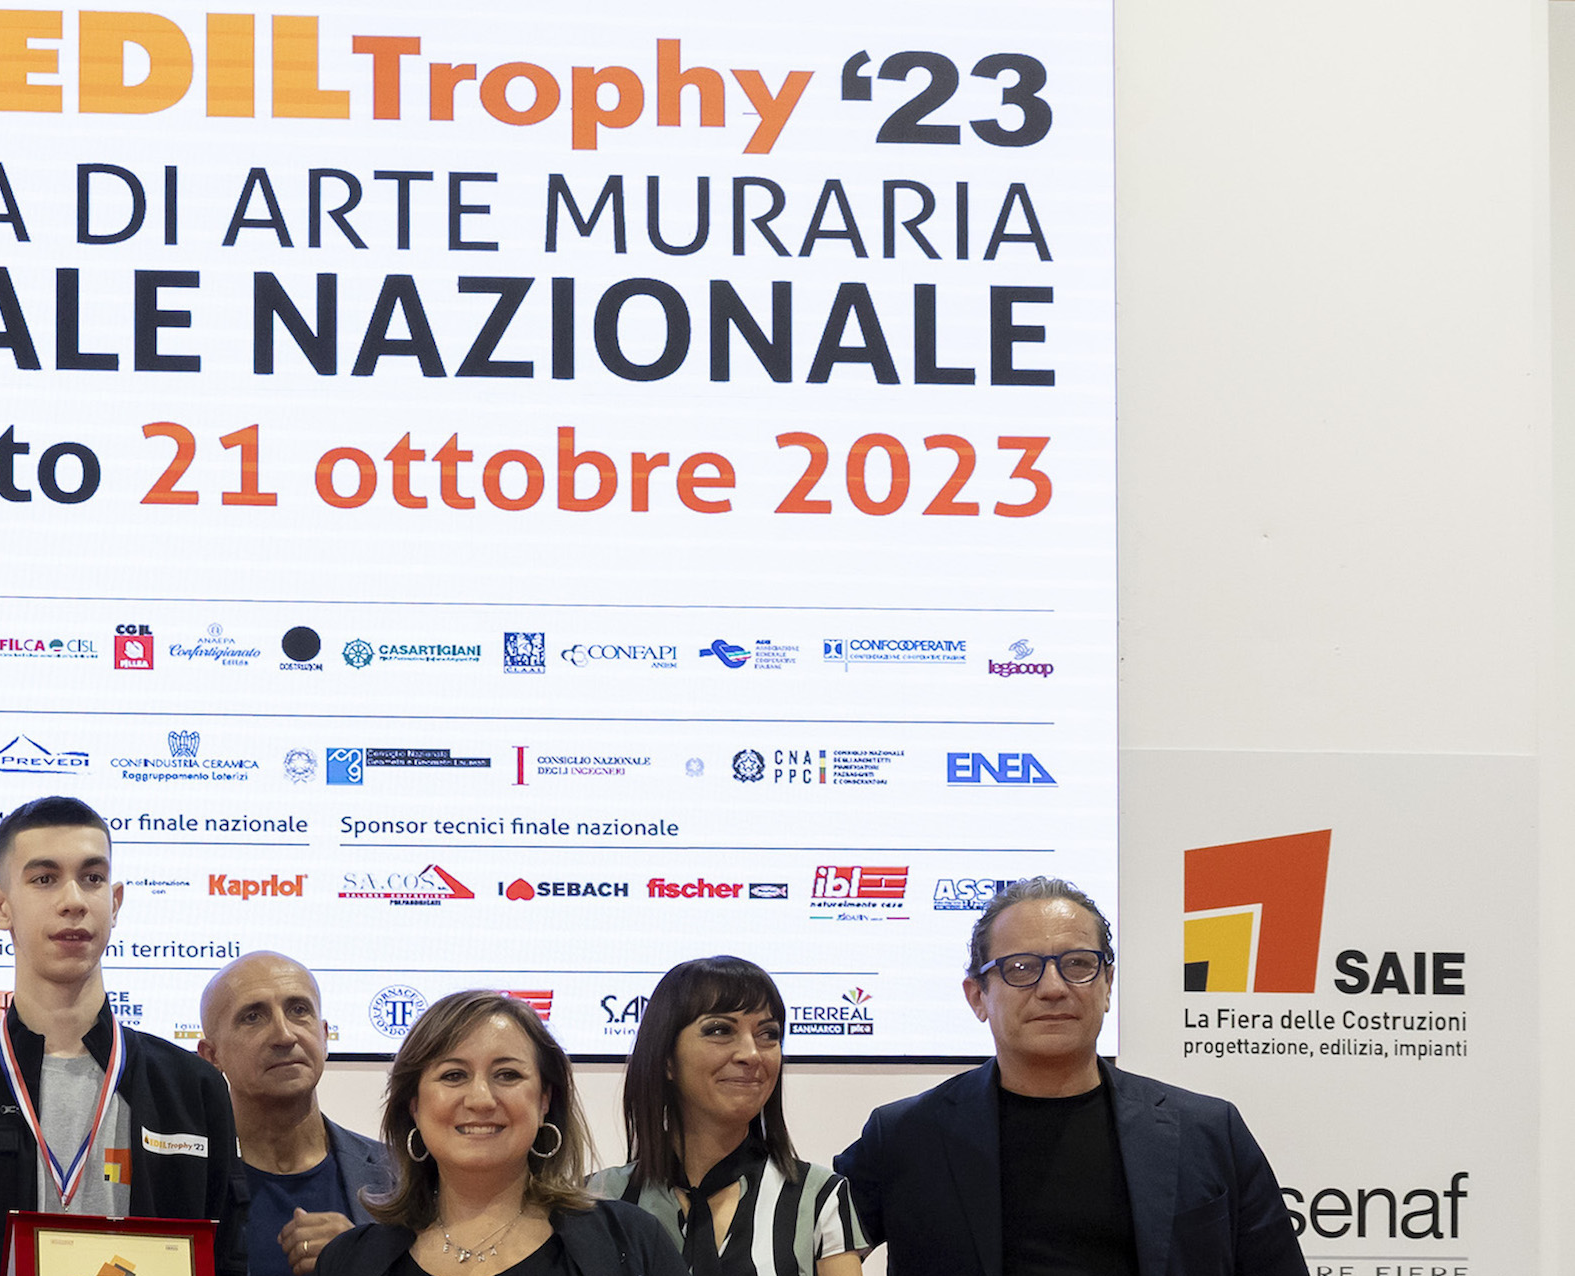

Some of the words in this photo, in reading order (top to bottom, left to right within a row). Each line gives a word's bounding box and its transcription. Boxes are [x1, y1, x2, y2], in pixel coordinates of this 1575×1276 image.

[77, 164, 177, 248] DI
[222, 167, 498, 253] ARTE
[545, 173, 1054, 264] MURARIA
[255, 271, 1057, 387] NAZIONALE
[140, 422, 278, 506] 21
[314, 426, 737, 515] ottobre
[774, 431, 1054, 520] 2023
[0, 639, 45, 651] FILCA
[67, 639, 98, 652] CISL
[169, 645, 260, 660] Confartigianato
[379, 645, 481, 656] CASARTIGIANI
[588, 645, 677, 659] CONFAPI
[850, 640, 966, 652] CONFCOOPERATIVE
[988, 659, 1054, 678] legacoop
[2, 757, 89, 767] PREVEDI
[111, 759, 199, 768] CONFINDUSTRIA
[202, 760, 259, 769] CERAMICA
[593, 757, 651, 766] NAZIONALE
[947, 753, 1057, 784] ENEA
[122, 771, 209, 782] Raggruppamento
[212, 772, 248, 781] Laterizi
[139, 814, 198, 831] finale
[204, 815, 308, 833] nazionale
[341, 817, 427, 835] Sponsor
[435, 818, 504, 834] tecnici
[511, 818, 570, 835] finale
[577, 819, 679, 836] nazionale
[538, 882, 628, 897] SEBACH
[647, 878, 743, 898] fischer
[132, 942, 240, 957] territoriali
[1333, 949, 1466, 995] SAIE
[790, 1006, 874, 1020] TERREAL
[1184, 1008, 1209, 1028] La
[1217, 1008, 1273, 1029] Fiera
[1280, 1010, 1335, 1030] delle
[1343, 1010, 1467, 1032] Costruzioni
[1184, 1038, 1314, 1058] progettazione,
[1319, 1040, 1389, 1058] edilizia,
[1394, 1040, 1468, 1060] impianti
